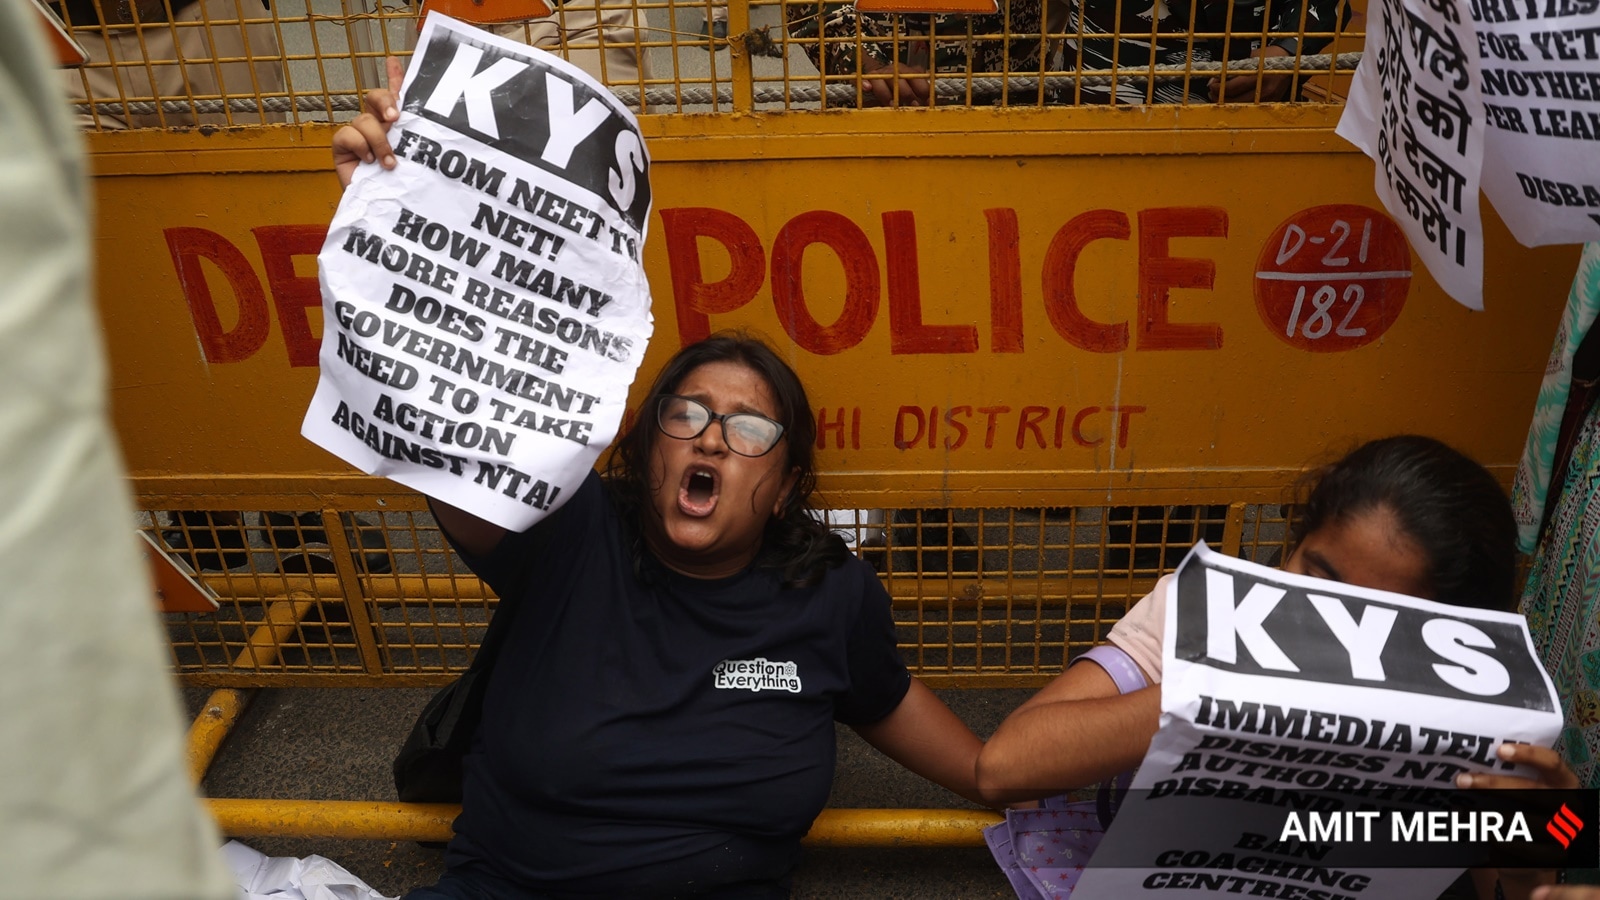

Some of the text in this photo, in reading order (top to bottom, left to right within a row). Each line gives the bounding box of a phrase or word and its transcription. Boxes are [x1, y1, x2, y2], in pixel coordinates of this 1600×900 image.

[1530, 27, 1600, 61] YET
[1414, 82, 1473, 156] को
[1481, 68, 1600, 102] NOTHE
[424, 43, 645, 212] KYS
[393, 129, 639, 264] FROM NEET TO
[1400, 115, 1467, 214] देना
[392, 208, 613, 318] HOW MANY
[471, 202, 566, 262] NET!
[1276, 218, 1371, 266] D-21
[342, 227, 634, 362] MORE REASONS
[659, 206, 1229, 355] POLICE
[1285, 284, 1366, 339] 182
[335, 300, 601, 414] GOVERNMENT
[385, 283, 568, 375] DOES THE
[336, 331, 418, 391] NEED
[428, 375, 479, 415] TO
[489, 398, 593, 446] TAKE
[331, 401, 561, 511] AGAINST NTA!
[374, 393, 517, 456] ACTION
[894, 405, 1146, 450] DISTRICT
[1205, 567, 1511, 696] KYS
[715, 661, 784, 676] Question
[717, 674, 799, 690] Everything
[1194, 735, 1390, 774] DISMISS
[1195, 695, 1531, 771] IMMEDIATEL
[1146, 777, 1345, 813] DISBAND
[1172, 753, 1476, 808] AUTHORITIES
[1155, 851, 1371, 892] COACHING
